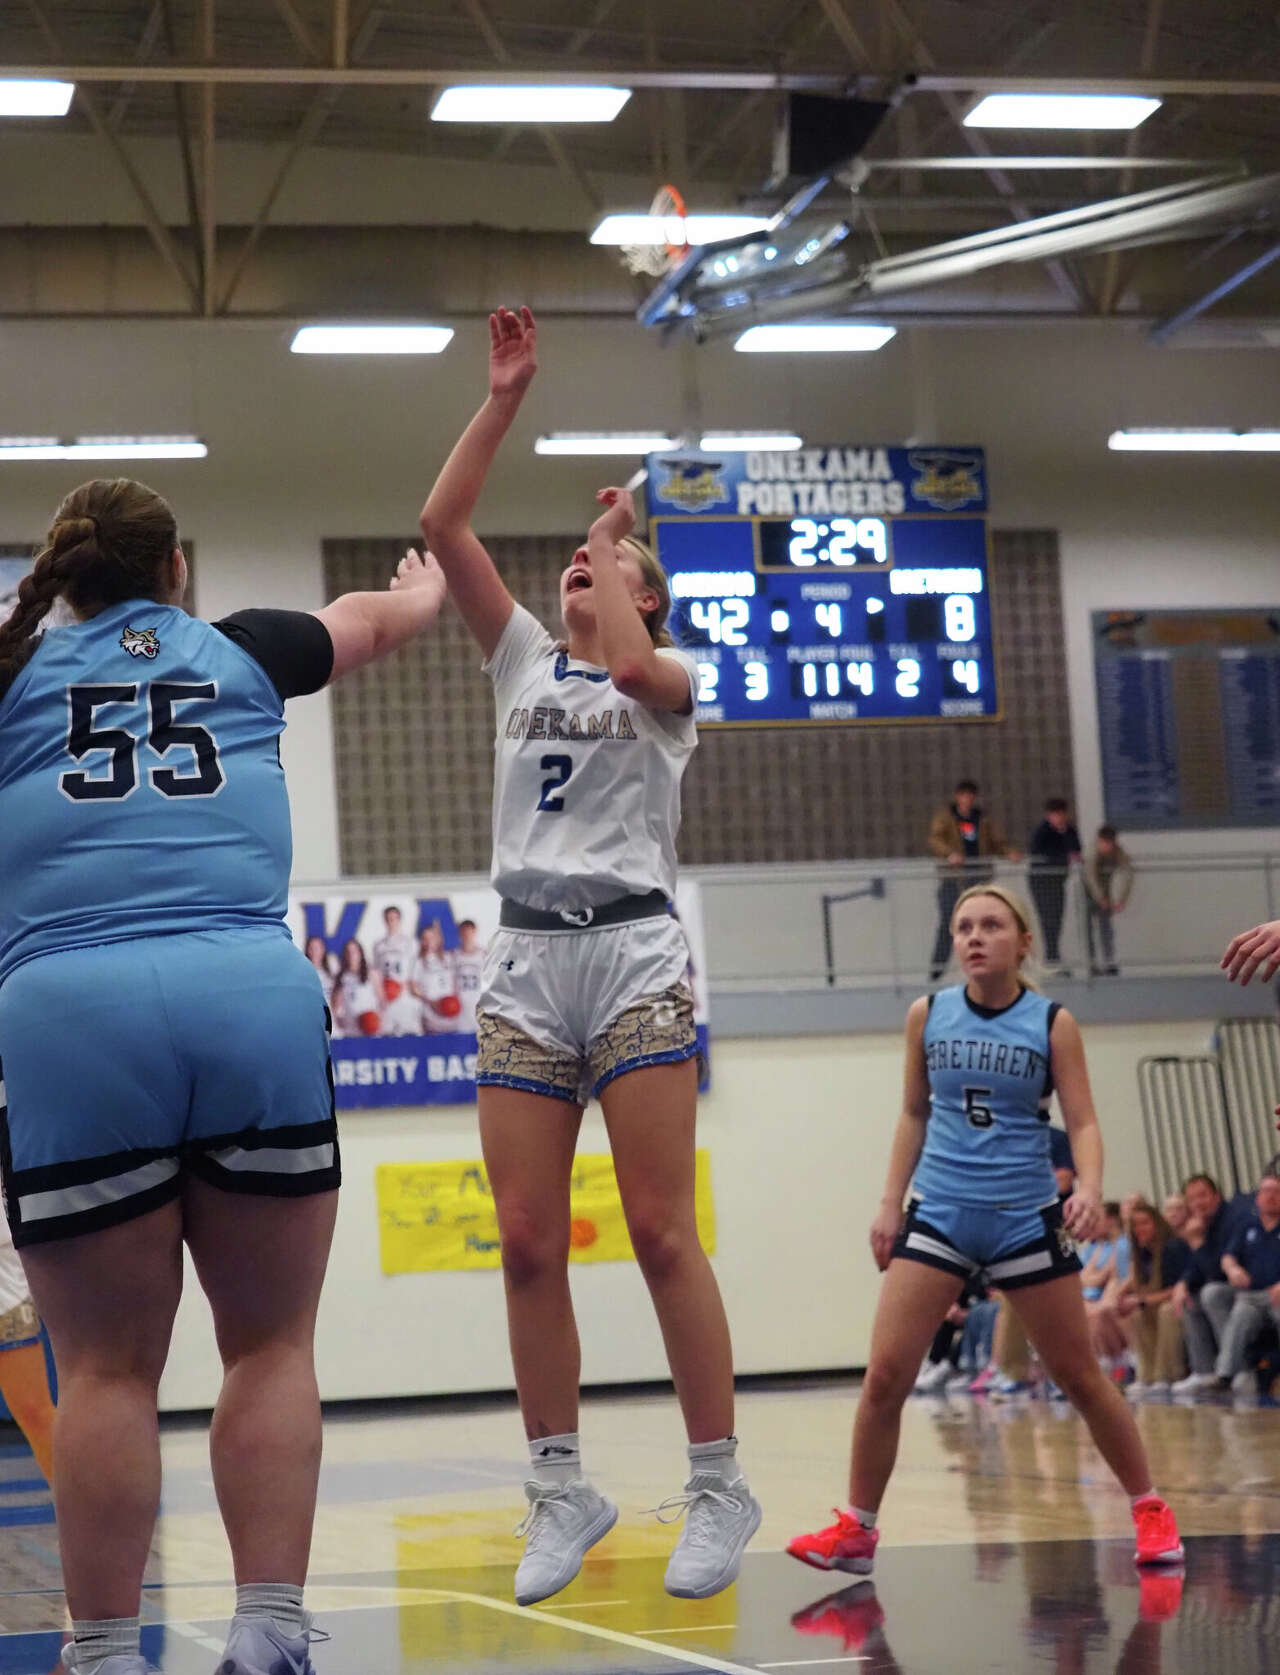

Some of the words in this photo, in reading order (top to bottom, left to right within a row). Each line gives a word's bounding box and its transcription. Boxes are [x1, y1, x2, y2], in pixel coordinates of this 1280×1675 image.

[745, 450, 893, 480] ONEKAMA
[736, 481, 905, 515] PORTAGERS
[789, 518, 887, 567] 2:29
[691, 598, 749, 645] 42
[815, 603, 842, 637] 4
[944, 595, 976, 641] 8
[744, 661, 769, 701] 3
[895, 658, 920, 697] 2
[952, 660, 979, 693] 4
[58, 680, 227, 803] 55
[536, 754, 573, 812] 2
